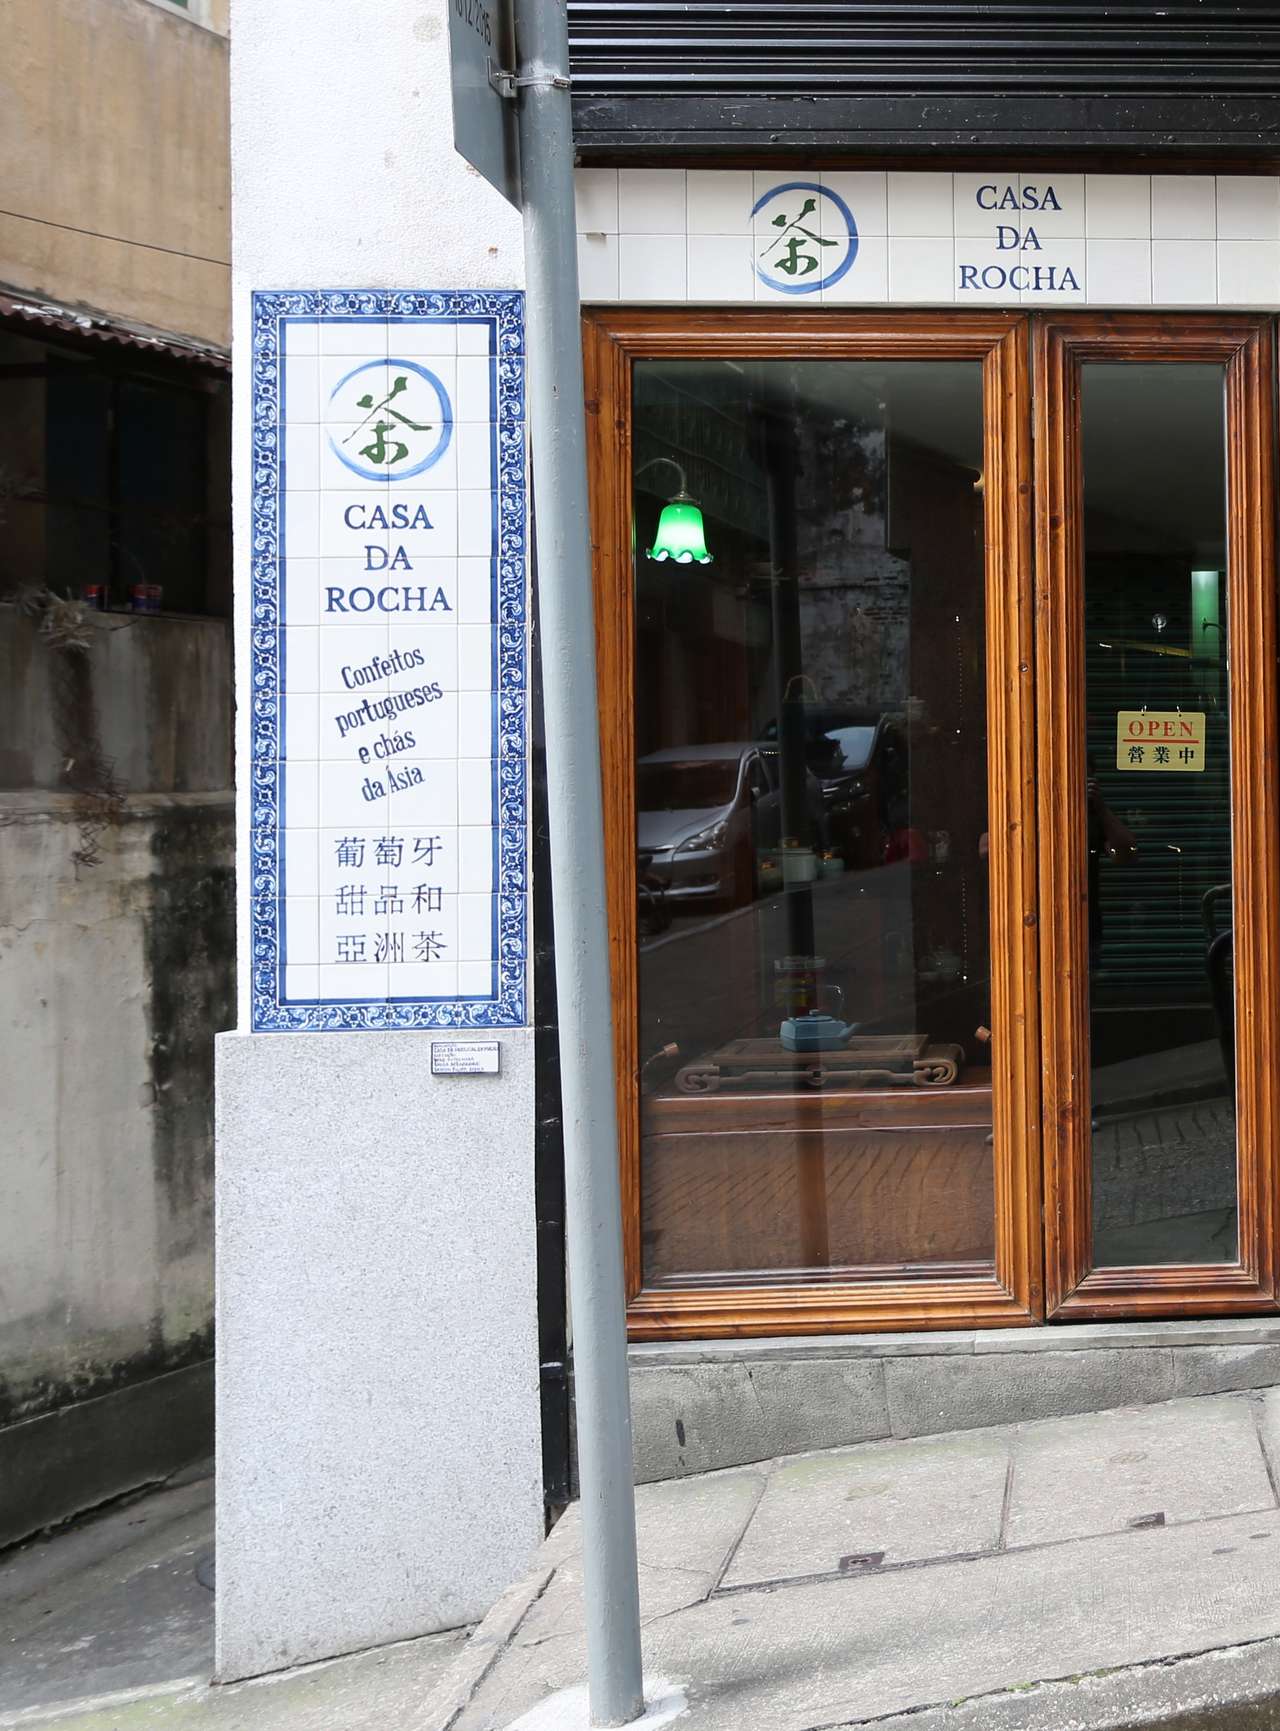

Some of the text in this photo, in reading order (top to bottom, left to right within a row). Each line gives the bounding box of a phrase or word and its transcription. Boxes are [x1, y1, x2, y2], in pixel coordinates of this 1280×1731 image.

[976, 184, 1062, 210] CASA
[996, 226, 1042, 250] DA
[959, 266, 1081, 290] ROCHA
[344, 504, 434, 529] CASA
[364, 546, 413, 570] DA
[325, 587, 453, 612] ROCHA
[341, 648, 425, 689] Confeitos
[334, 681, 444, 738] portugueses
[1128, 720, 1193, 737] OPEN
[358, 730, 416, 764] e chás
[1128, 746, 1194, 764] 營業中
[361, 765, 425, 802] da Ásia
[334, 836, 443, 868] 葡萄牙
[335, 883, 442, 916] 甜品和
[335, 931, 448, 963] 亞洲茶
